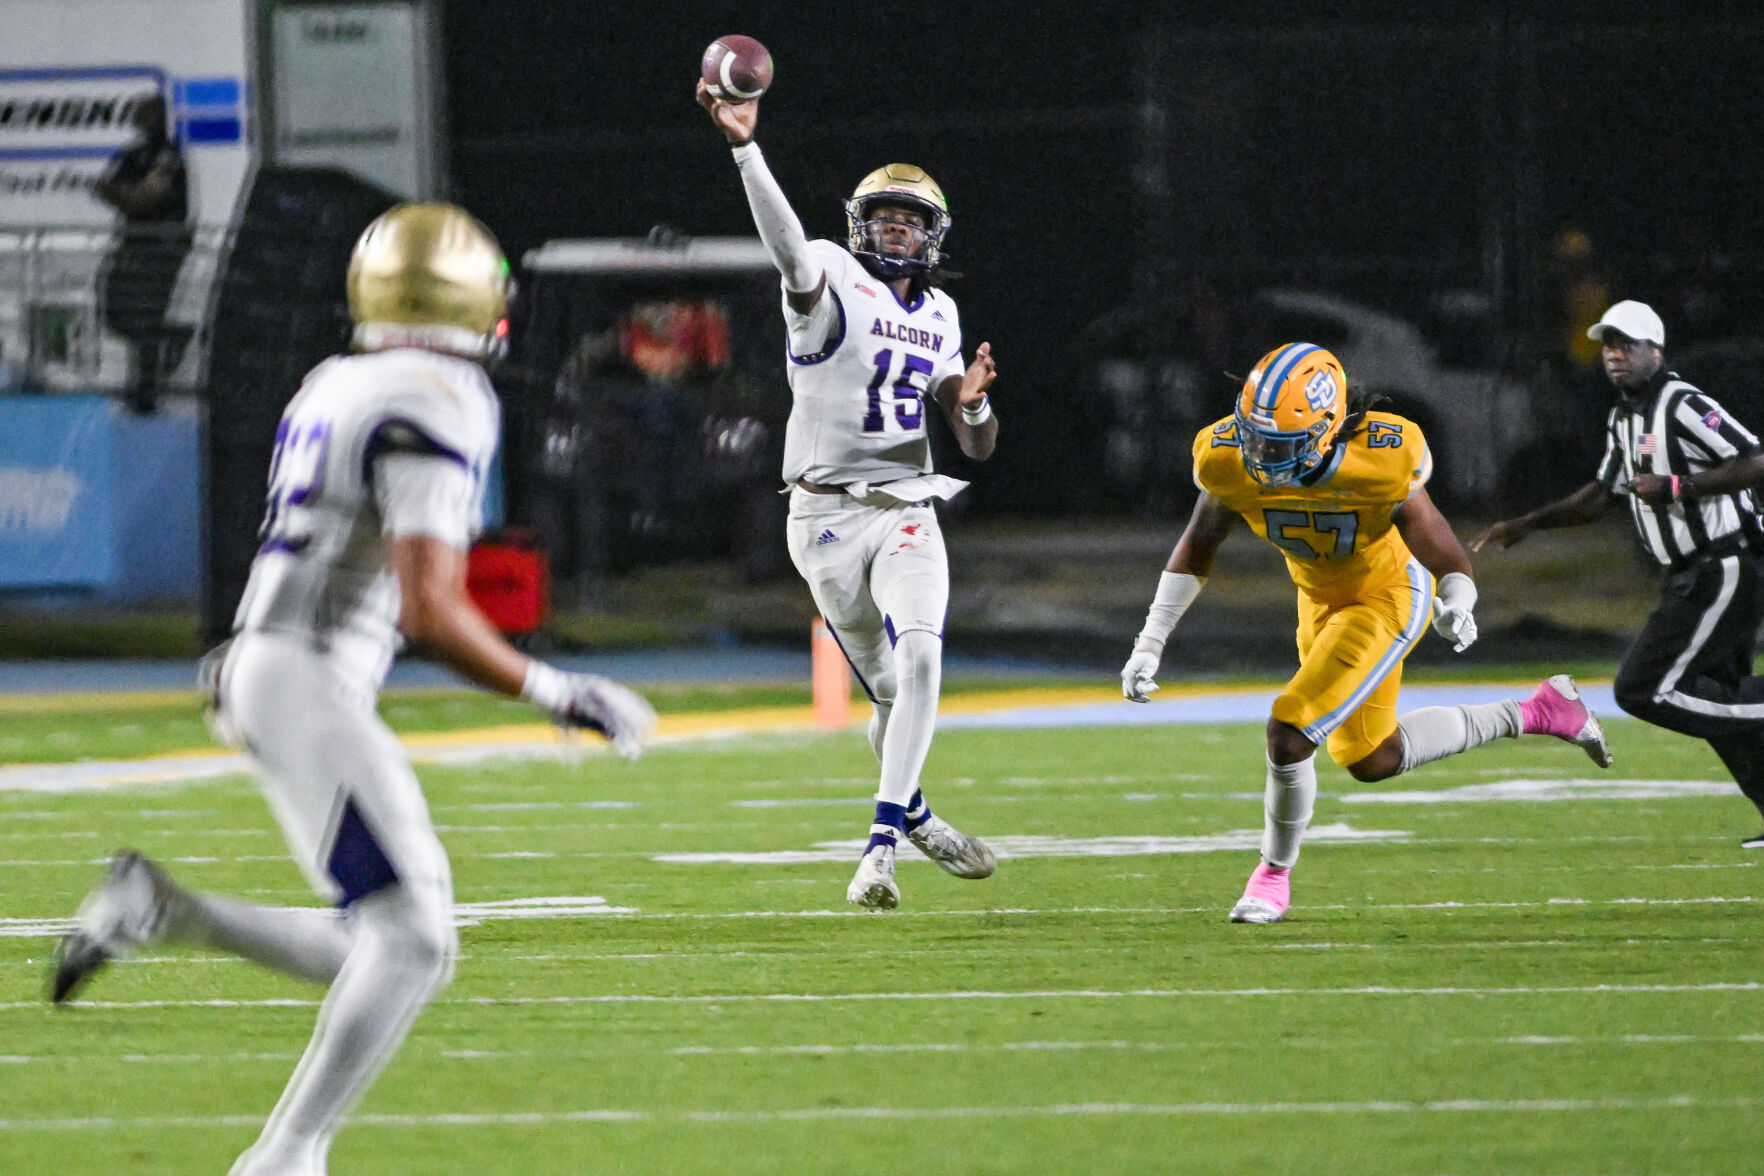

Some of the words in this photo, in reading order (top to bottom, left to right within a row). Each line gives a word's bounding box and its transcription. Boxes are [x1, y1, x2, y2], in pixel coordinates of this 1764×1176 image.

[870, 318, 943, 352] ALCORN
[863, 348, 934, 432] 15
[1368, 421, 1402, 448] 57
[1262, 509, 1359, 560] 57
